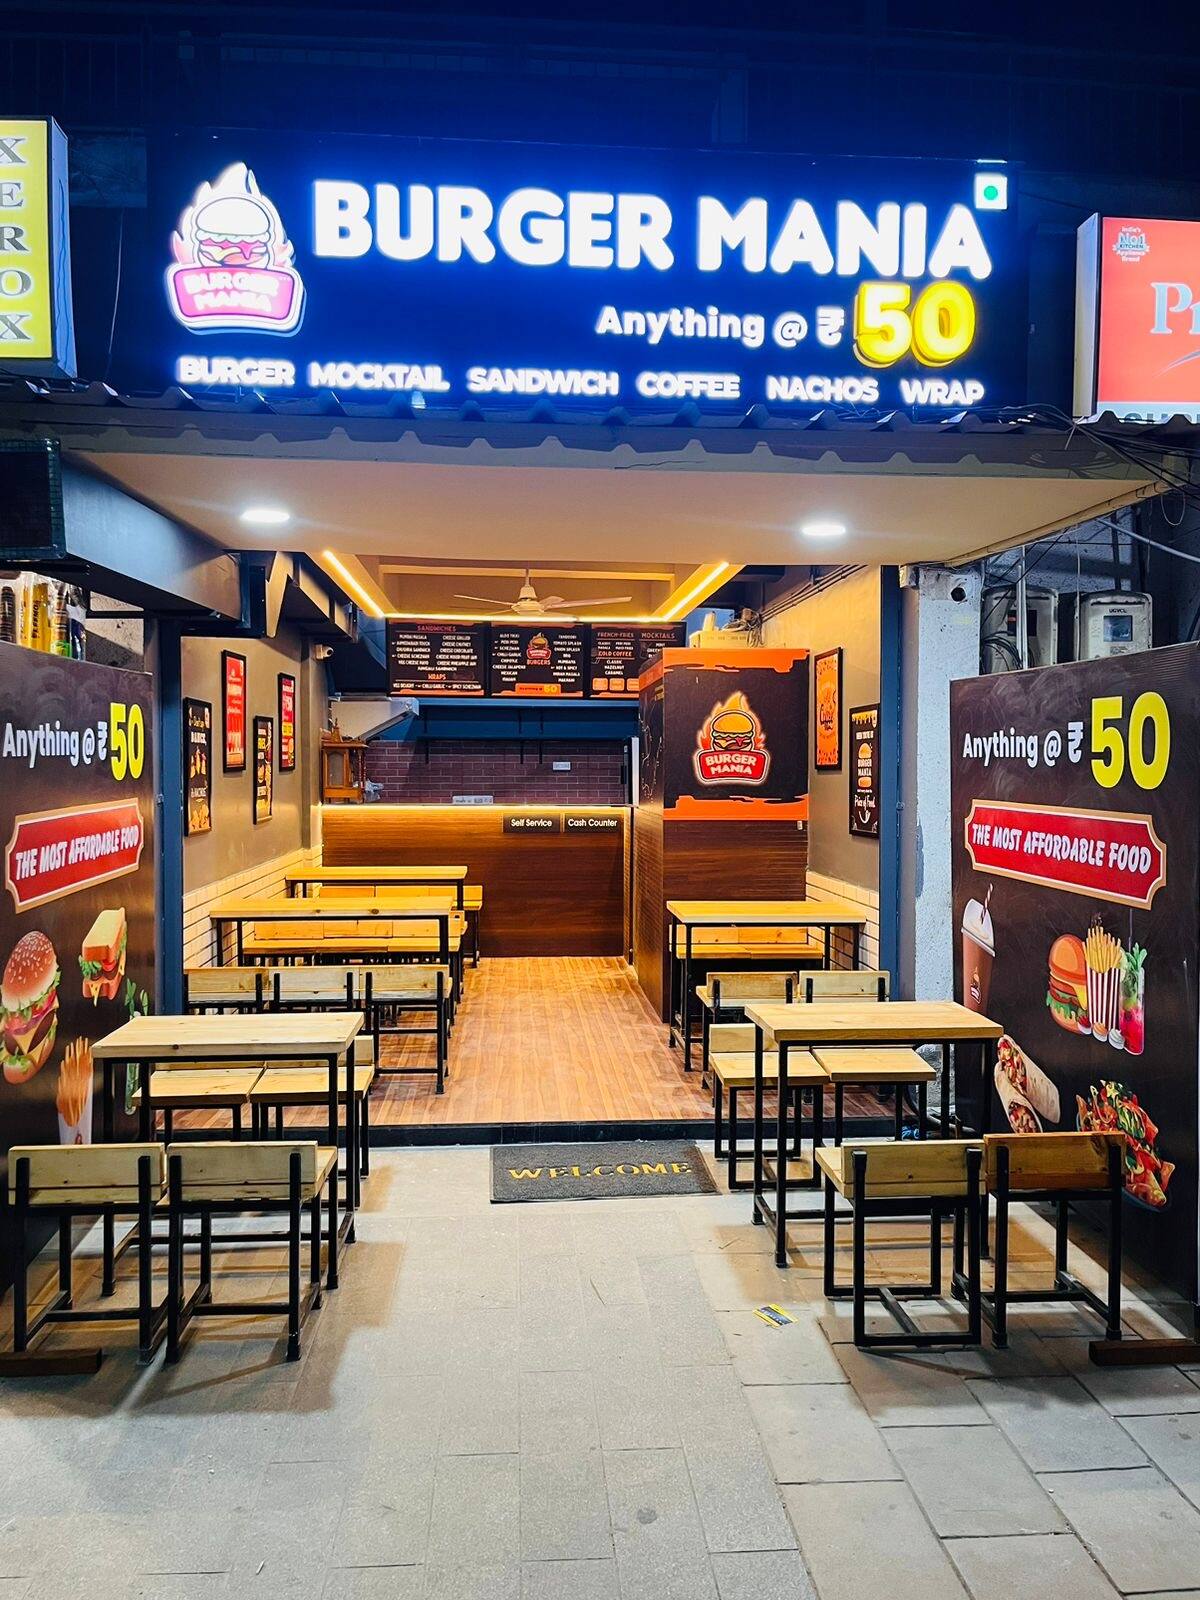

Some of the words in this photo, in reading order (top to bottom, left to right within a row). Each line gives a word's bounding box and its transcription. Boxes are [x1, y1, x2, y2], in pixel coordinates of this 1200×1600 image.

[0, 137, 32, 341] XEROX
[312, 179, 674, 271] BURGER
[697, 194, 993, 280] MANIA
[595, 306, 765, 347] Anything
[773, 311, 808, 347] @
[853, 280, 977, 368] 50
[178, 356, 295, 386] BURGER
[309, 362, 450, 392] MOCKTAIL
[466, 367, 620, 397] SANDWICH
[636, 371, 741, 399] COFFEE
[766, 374, 879, 402] NACHOS
[900, 379, 985, 405] WRAP
[2, 721, 79, 769] Anything
[82, 731, 95, 765] @
[110, 702, 145, 781] 50
[962, 727, 1039, 769] Anything
[1043, 730, 1062, 768] @
[1068, 721, 1084, 763] ₹
[1091, 691, 1171, 790] 50
[705, 753, 757, 767] BURGER
[710, 763, 753, 776] MANIA
[511, 818, 524, 827] Self
[526, 818, 552, 827] Service
[568, 818, 587, 827] Cash
[588, 818, 617, 827] Counter
[15, 849, 37, 881] THE
[39, 843, 65, 874] MOST
[68, 830, 120, 864] AFFORDABLE
[121, 824, 140, 851] FOOD
[972, 823, 991, 846] THE
[992, 825, 1020, 852] MOST
[1023, 831, 1104, 867] AFFORDABLE
[1108, 843, 1151, 874] FOOD
[508, 1161, 693, 1180] WELCOME
